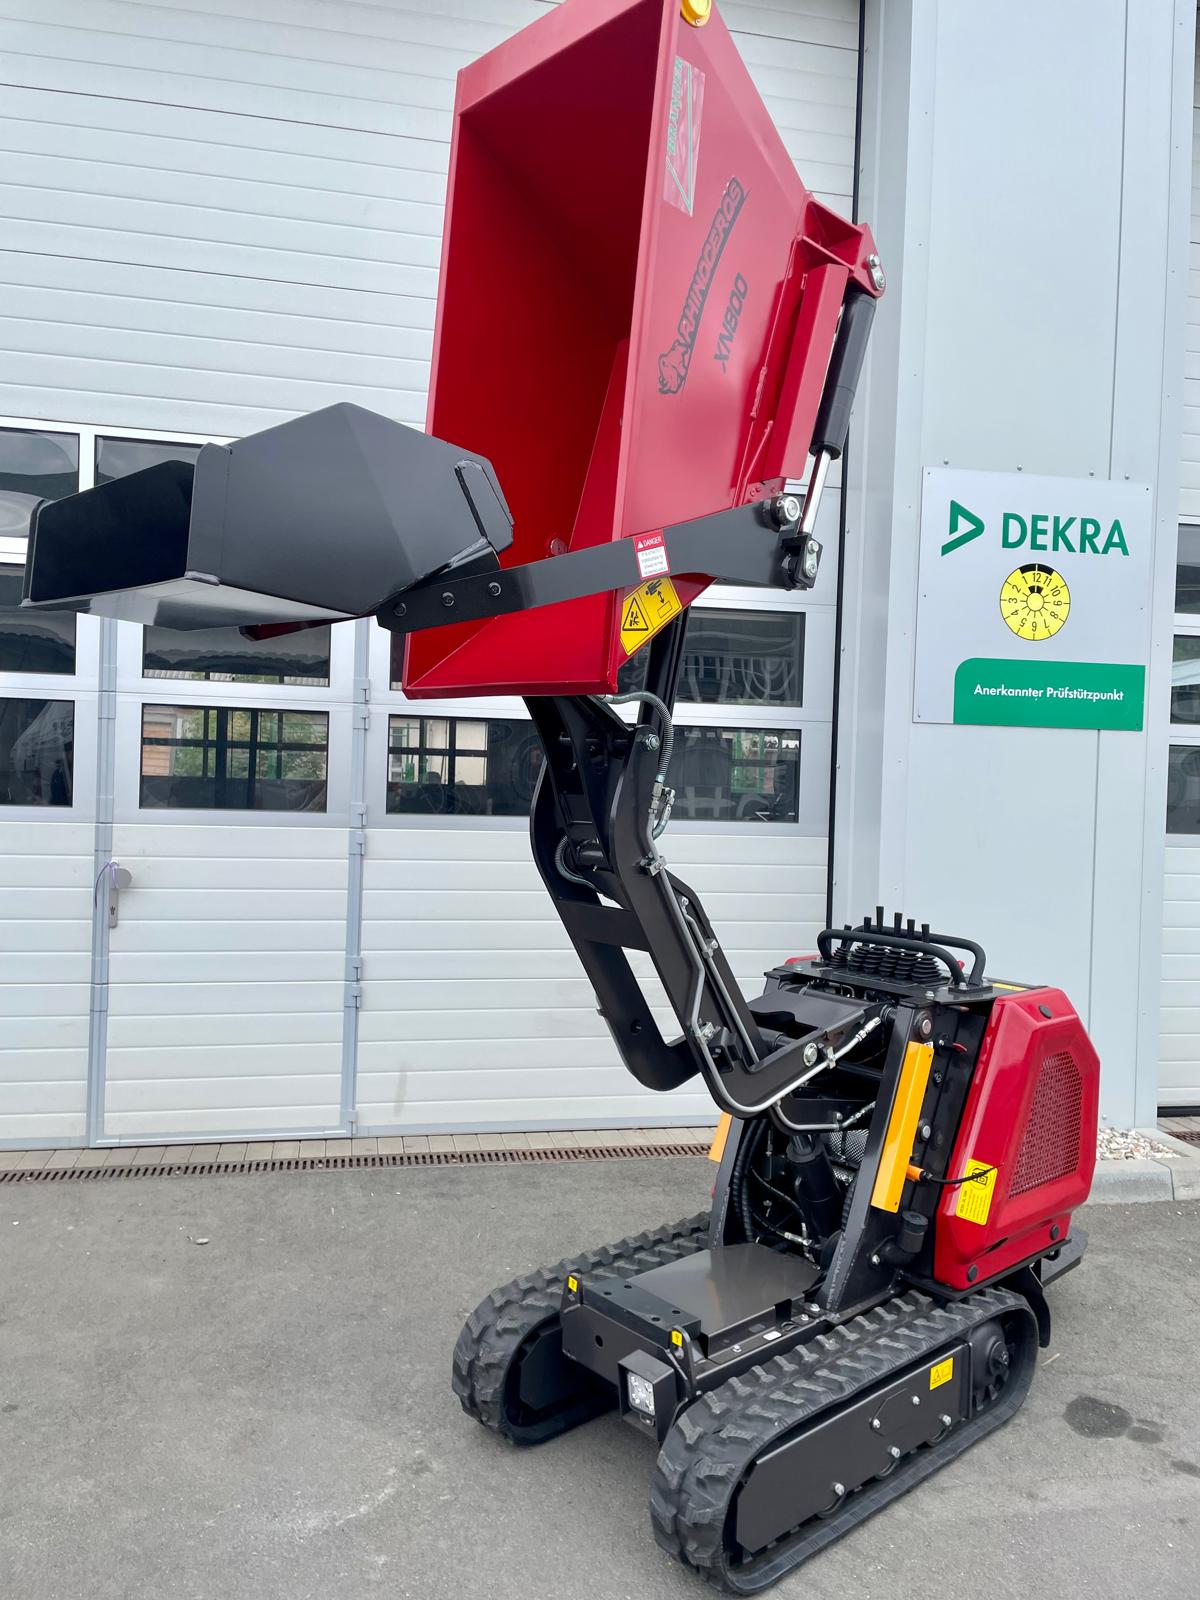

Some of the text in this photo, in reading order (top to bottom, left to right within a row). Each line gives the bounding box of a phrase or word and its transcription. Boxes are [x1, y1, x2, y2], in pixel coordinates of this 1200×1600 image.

[677, 176, 745, 350] RHINOCEROS
[714, 272, 748, 374] XN800
[1001, 512, 1129, 556] DEKRA
[1022, 575, 1028, 585] 1
[1032, 572, 1041, 583] 12
[1043, 575, 1052, 587] 11
[1012, 584, 1021, 593] 2
[1050, 585, 1061, 597] 10
[1050, 611, 1059, 619] 8
[1019, 617, 1028, 627] 5
[1031, 621, 1037, 632] 6
[1043, 618, 1050, 629] 7
[973, 683, 1124, 702] Anerkannter Prüfstützpunkt
